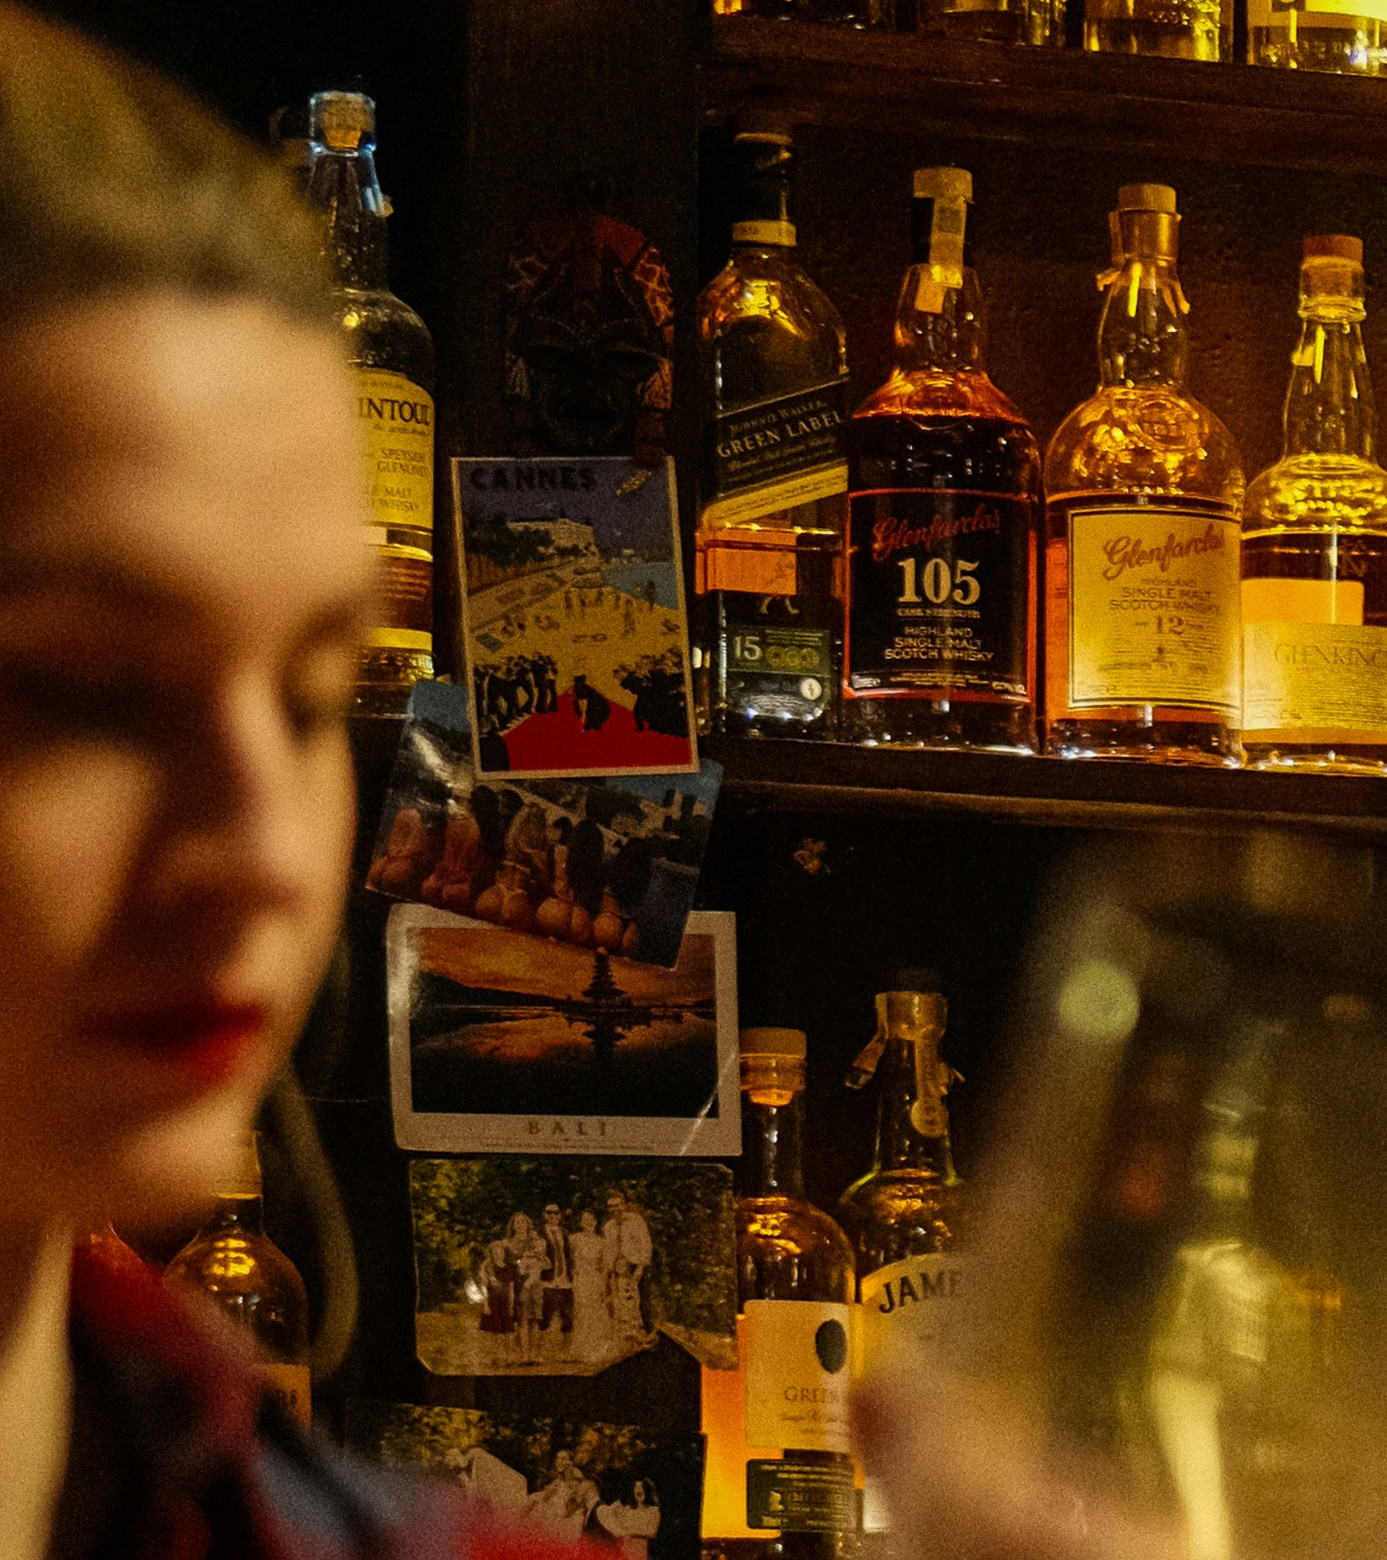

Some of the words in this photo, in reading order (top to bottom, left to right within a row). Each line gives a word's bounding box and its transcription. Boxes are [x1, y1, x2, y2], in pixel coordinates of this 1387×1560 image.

[358, 397, 431, 427] INTOUL
[716, 429, 781, 458] GREEN
[784, 410, 845, 438] LABEL
[469, 466, 597, 491] CANNES
[896, 557, 981, 606] 105
[1121, 586, 1176, 599] SINGLE
[1110, 598, 1175, 612] SCOTCH
[904, 625, 974, 638] HIGHLAND
[732, 635, 763, 661] 15
[894, 637, 945, 650] SINGLE
[947, 639, 983, 650] MALT
[884, 648, 939, 660] SCOTCH
[942, 649, 995, 662] WHISKY
[527, 1118, 610, 1137] BALI
